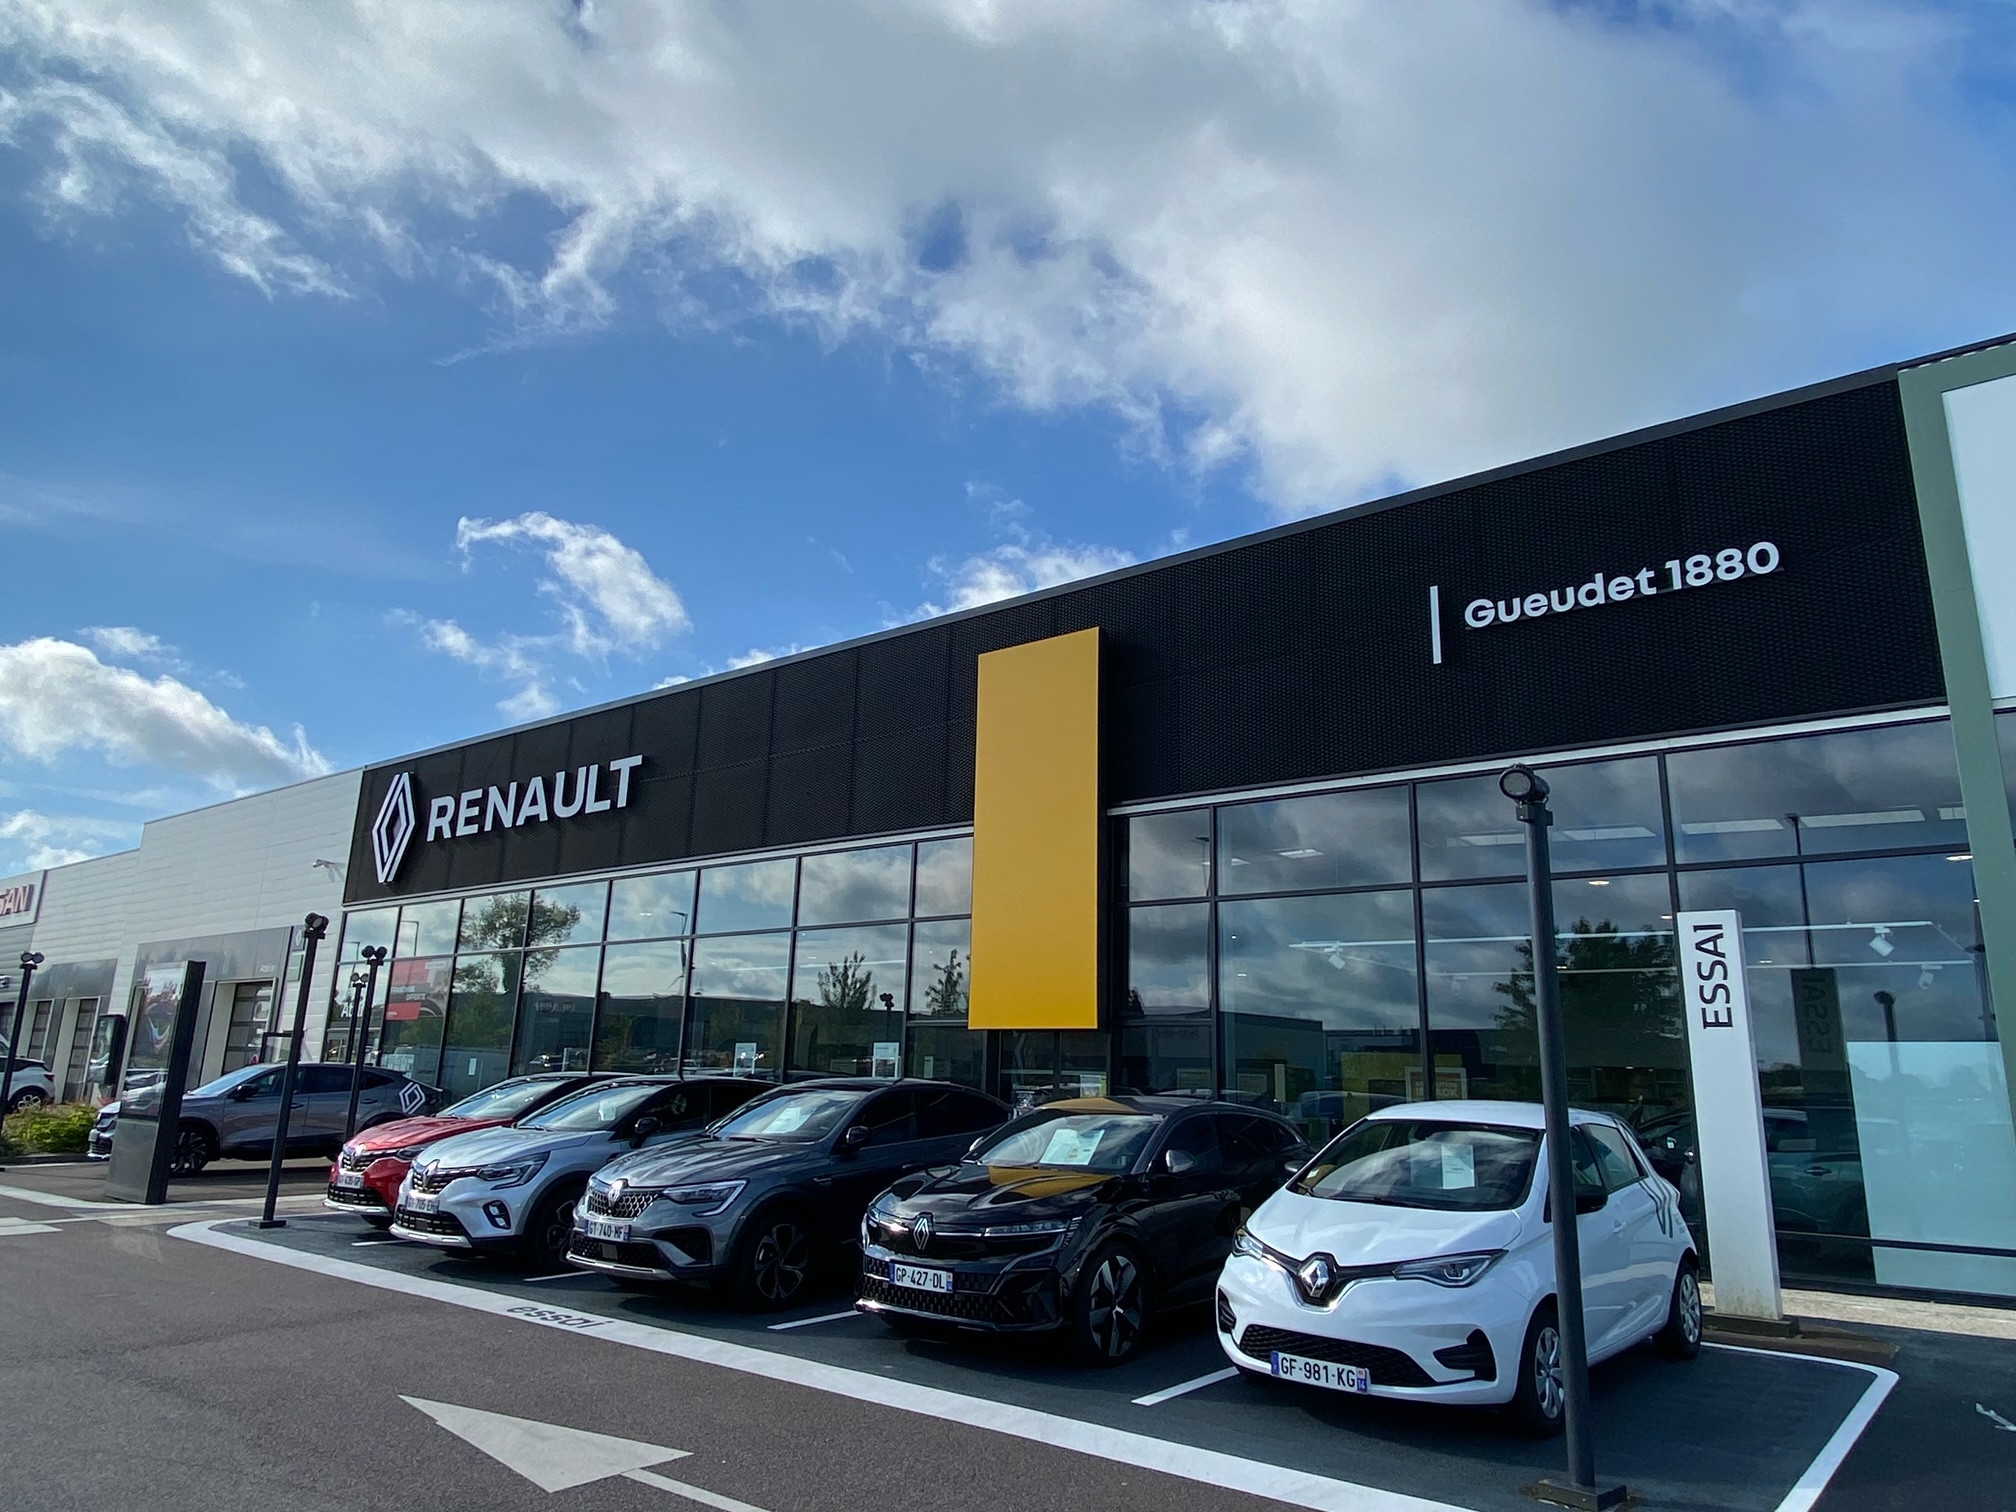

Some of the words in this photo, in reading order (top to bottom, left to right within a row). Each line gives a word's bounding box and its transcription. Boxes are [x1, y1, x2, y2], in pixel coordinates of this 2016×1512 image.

[1464, 567, 1657, 628] Gueudet
[1665, 541, 1780, 590] 1880
[426, 754, 643, 842] RENAULT
[1693, 924, 1733, 1029] ESSAI
[506, 1306, 615, 1329] essai
[1281, 1357, 1356, 1388] GF-981-KG
